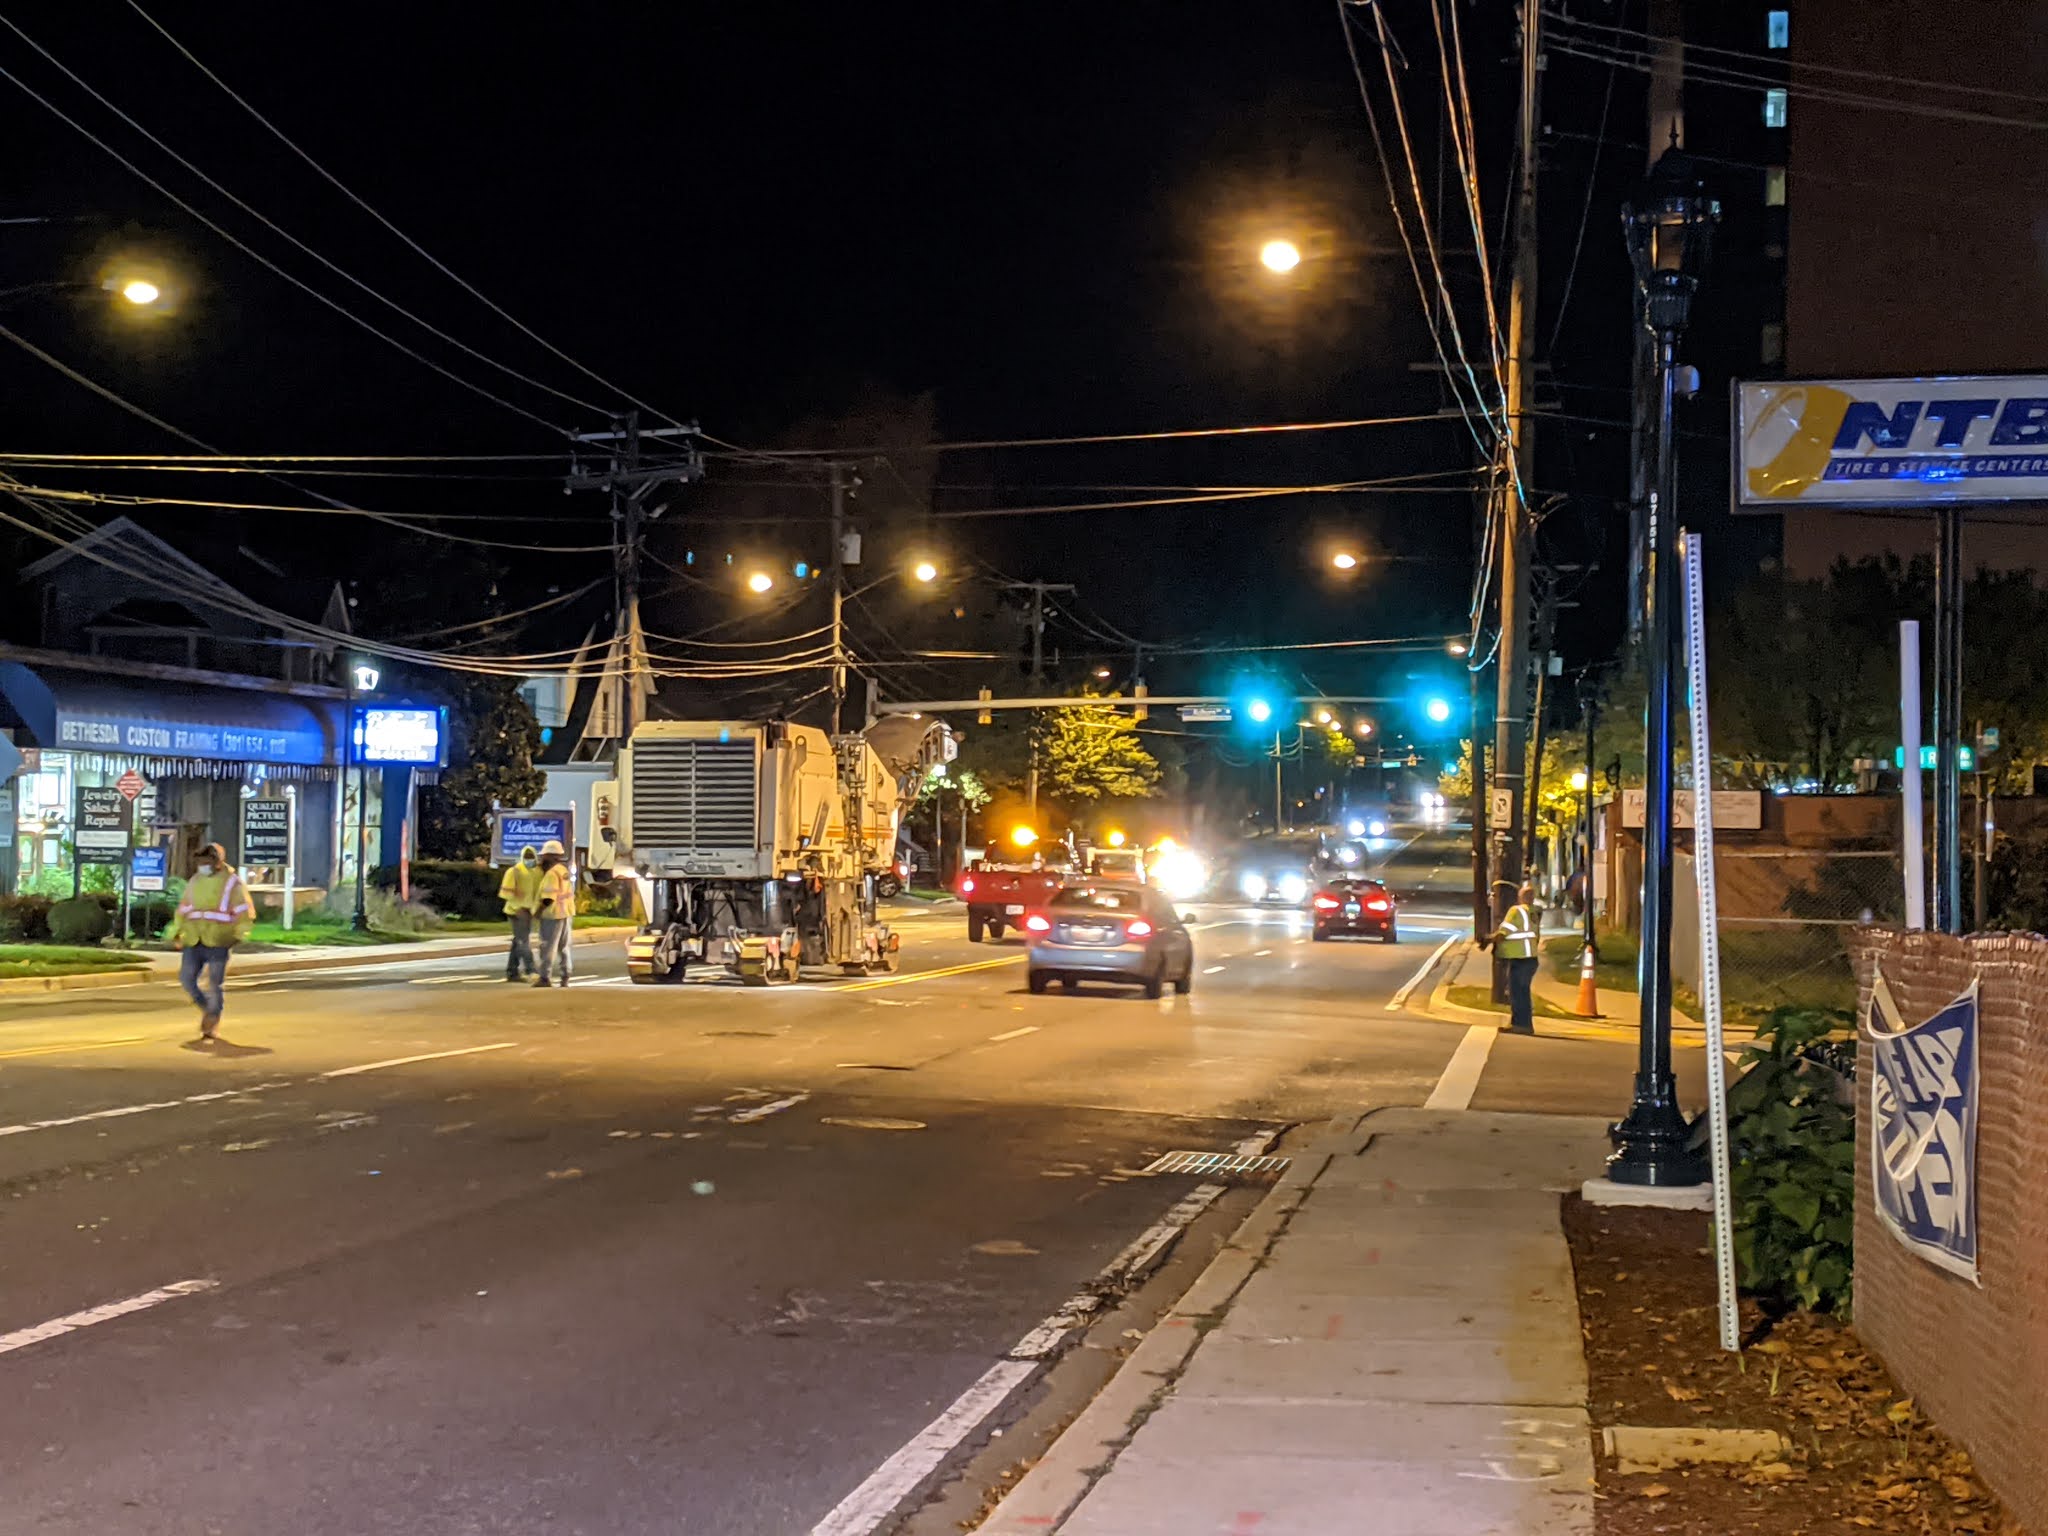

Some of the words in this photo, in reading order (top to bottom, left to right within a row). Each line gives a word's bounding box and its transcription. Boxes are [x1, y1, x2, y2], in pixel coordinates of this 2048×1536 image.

[1832, 398, 2048, 449] NTB
[1835, 462, 1873, 474] TIRE
[1879, 462, 1890, 473] &
[62, 721, 120, 745] BETHESDA
[127, 726, 170, 748] CUSTOM
[82, 789, 122, 804] Jewelry
[83, 801, 111, 813] Sales
[247, 803, 286, 812] QUALITY
[84, 815, 120, 828] Repair
[247, 811, 286, 820] PICTURE
[245, 821, 287, 830] FRAMING
